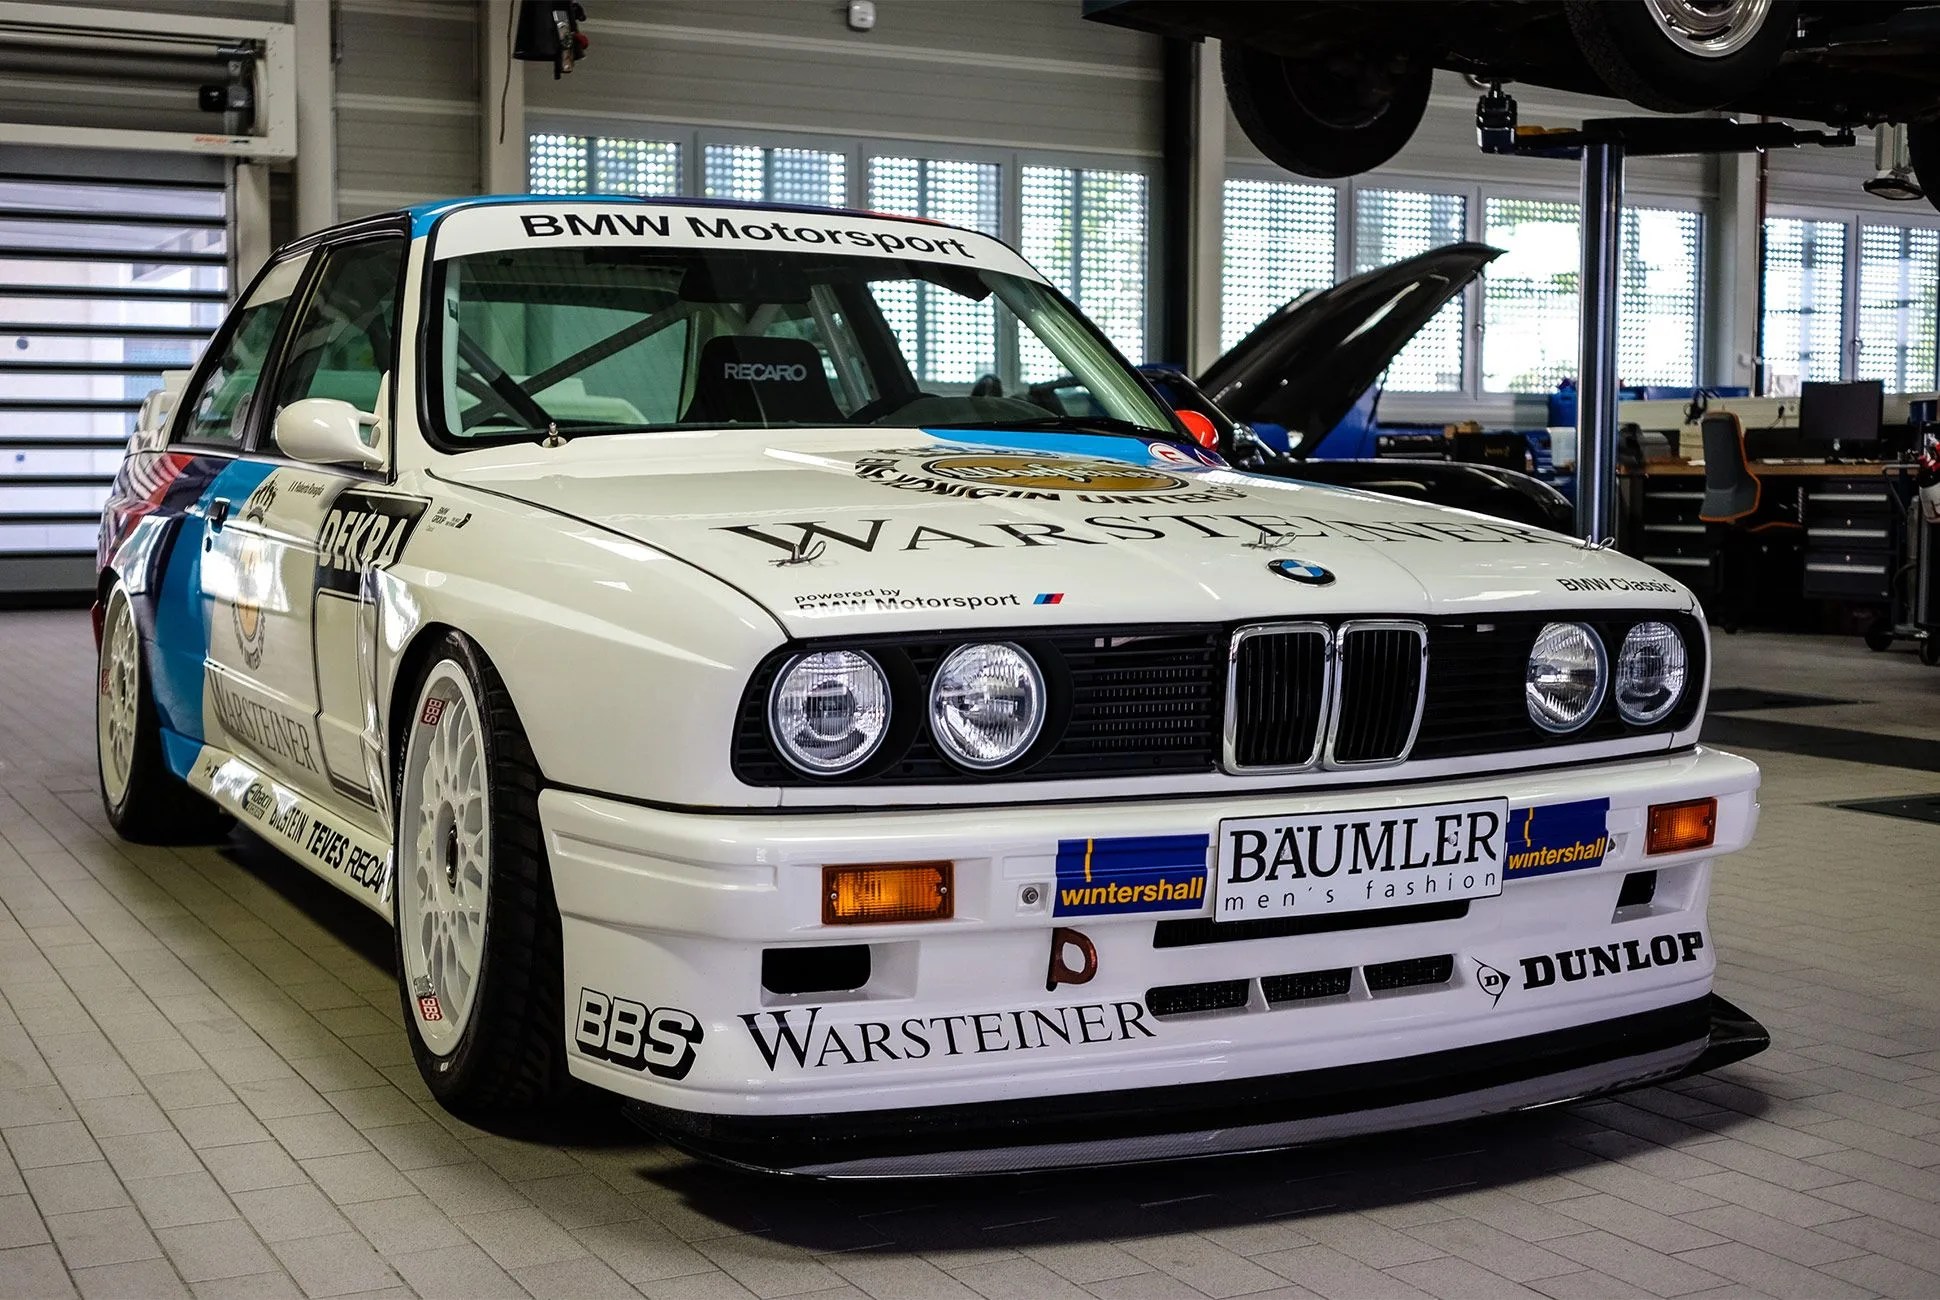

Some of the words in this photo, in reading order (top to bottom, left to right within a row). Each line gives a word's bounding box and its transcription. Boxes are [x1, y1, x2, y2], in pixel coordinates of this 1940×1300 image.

[519, 213, 671, 239] BMW
[685, 215, 976, 259] Motorsport
[724, 362, 808, 382] RECARO
[319, 509, 408, 574] DEKRA
[708, 514, 1582, 552] WARSTEINER
[794, 590, 875, 605] powered
[880, 588, 901, 599] by
[876, 592, 1021, 611] Motorsport
[1556, 577, 1612, 592] BMW
[1609, 578, 1676, 593] Classic
[424, 699, 443, 724] BBS
[305, 820, 350, 869] TEVES
[1227, 811, 1499, 884] BÄUMLER
[1509, 837, 1606, 870] wintershall
[1062, 877, 1203, 906] wintershall
[1366, 872, 1496, 899] fashion
[1519, 931, 1704, 990] DUNLOP
[421, 998, 440, 1020] BBS
[575, 987, 704, 1081] BBS
[737, 1001, 1157, 1072] WARSTEINER
